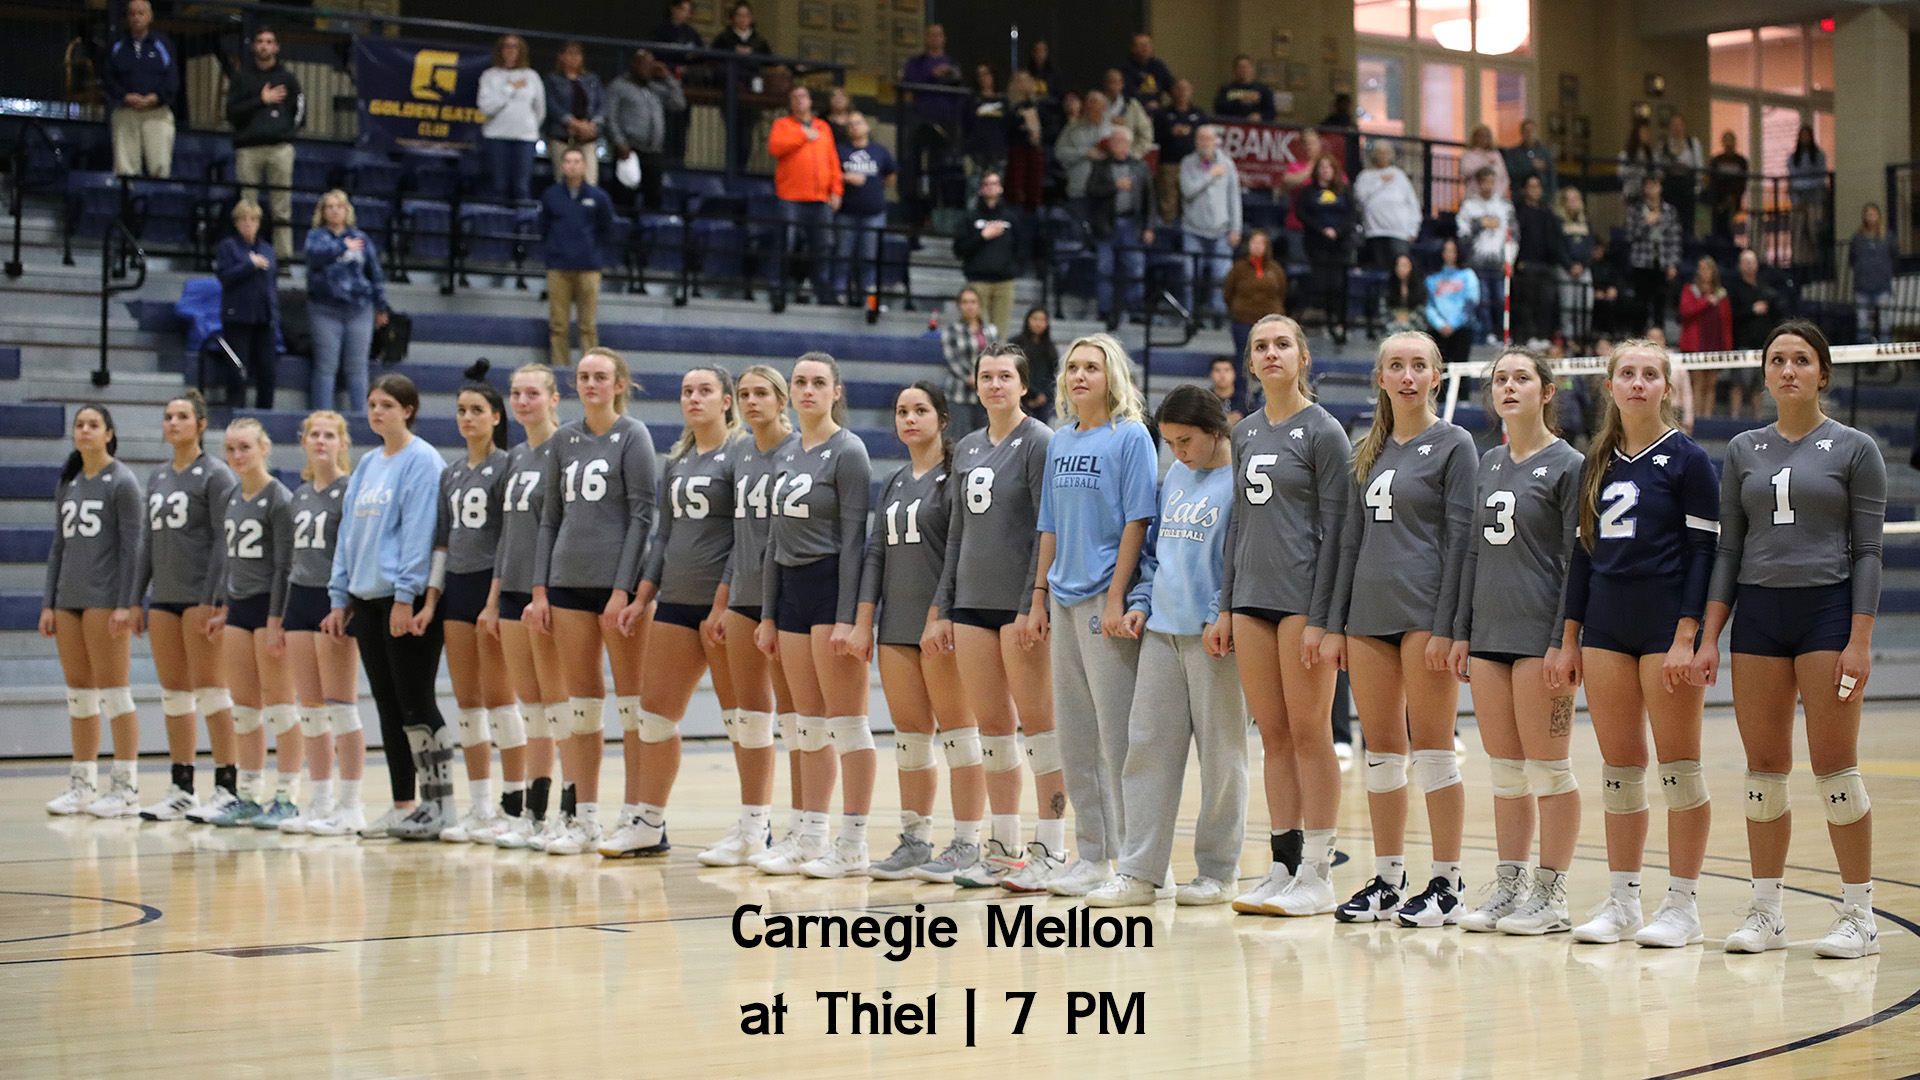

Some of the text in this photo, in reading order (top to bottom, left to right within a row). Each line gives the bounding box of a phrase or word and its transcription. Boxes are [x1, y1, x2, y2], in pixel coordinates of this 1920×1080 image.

[564, 457, 611, 503] 16
[1053, 455, 1102, 475] THIEL
[1244, 453, 1280, 506] 5
[149, 490, 190, 532] 23
[451, 487, 488, 530] 18
[502, 470, 542, 513] 17
[670, 475, 713, 520] 15
[734, 473, 771, 520] 14
[771, 471, 813, 520] 12
[966, 465, 996, 515] 8
[1161, 489, 1219, 528] Cats
[1364, 468, 1398, 523] 4
[1599, 480, 1641, 539] 2
[1769, 466, 1796, 526] 1
[61, 498, 105, 539] 25
[223, 518, 264, 560] 22
[294, 509, 328, 550] 21
[885, 498, 922, 547] 11
[1483, 489, 1518, 546] 3
